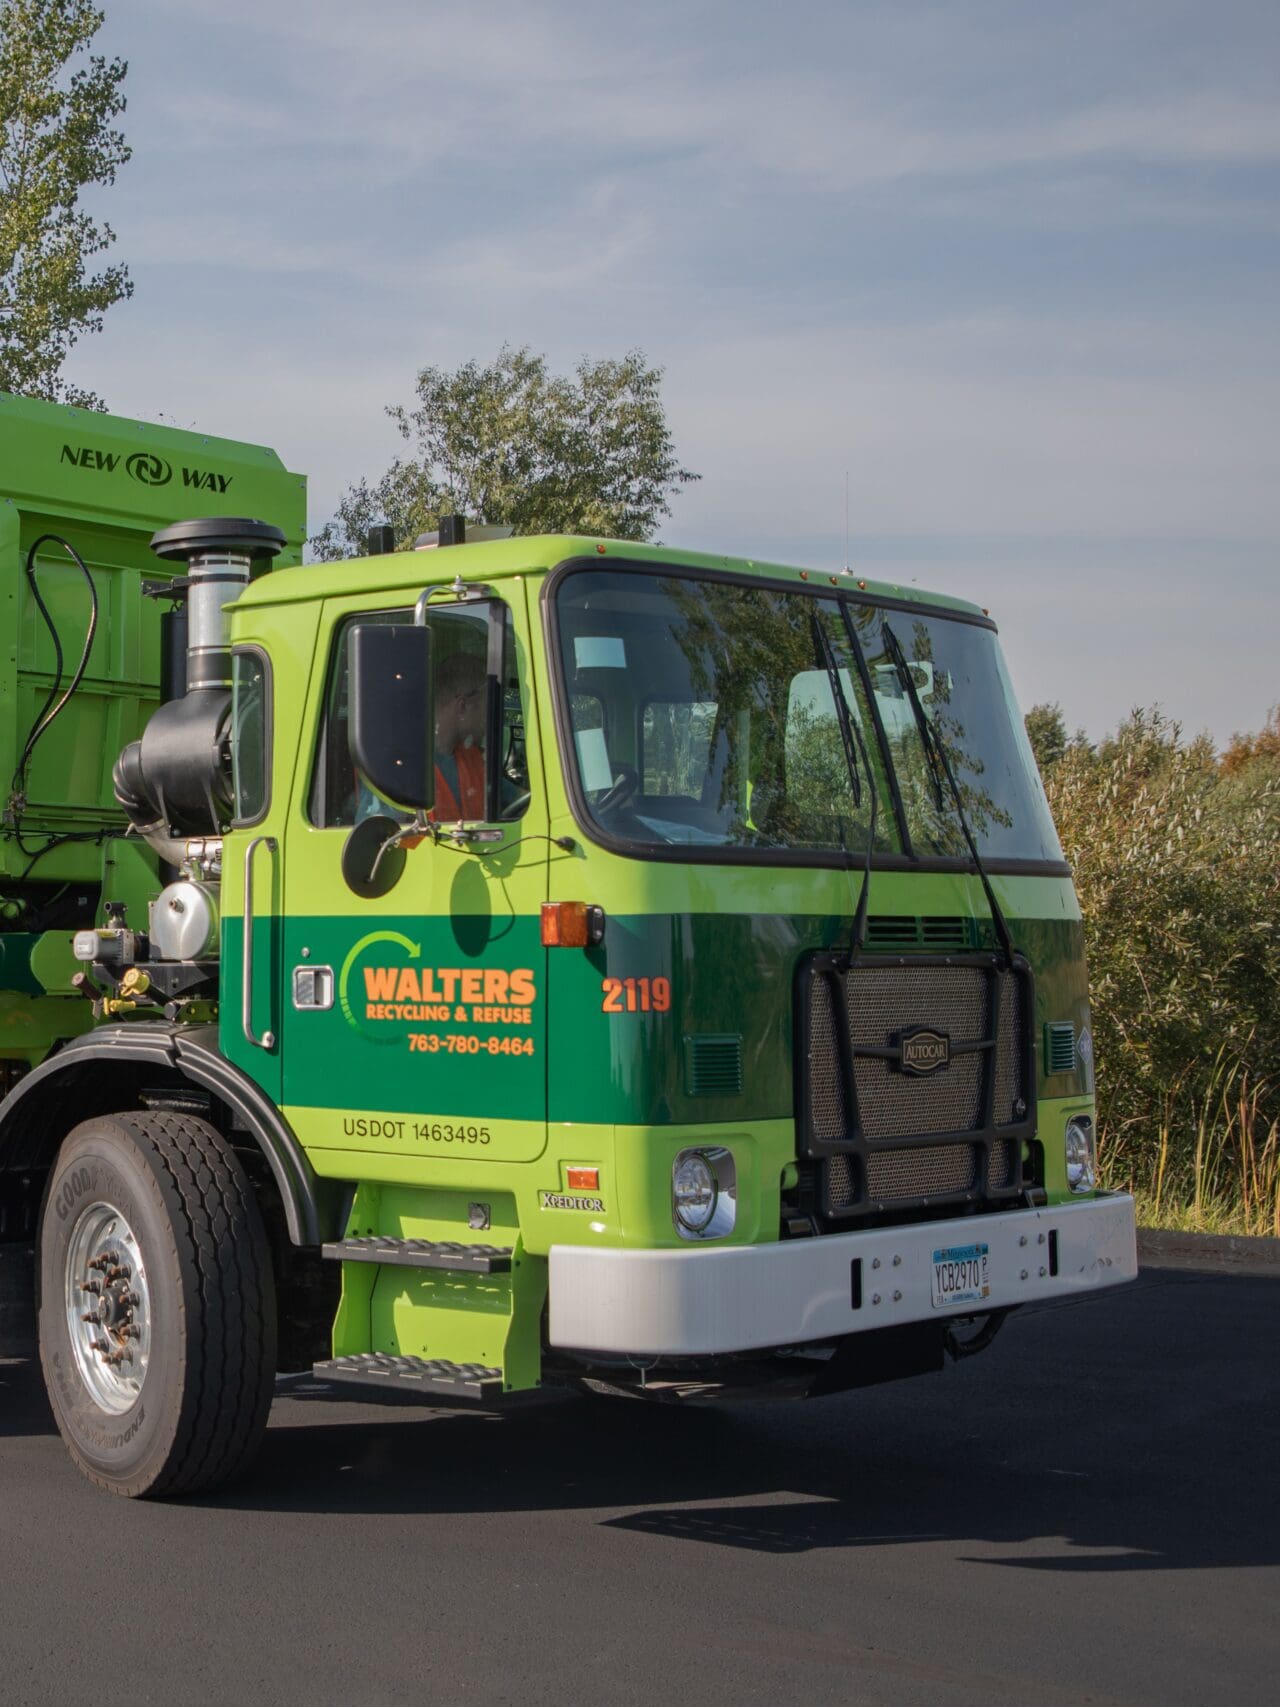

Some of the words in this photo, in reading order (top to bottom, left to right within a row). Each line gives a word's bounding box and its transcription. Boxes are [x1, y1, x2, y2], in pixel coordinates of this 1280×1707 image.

[60, 444, 121, 473] NEW
[181, 467, 233, 494] WAY
[363, 967, 537, 1005] WALTERS
[601, 975, 671, 1013] 2119
[366, 1004, 450, 1021] RECYCLING
[454, 1006, 468, 1022] &
[473, 1007, 532, 1024] REFUSE
[408, 1033, 535, 1056] 763-780-8464
[905, 1044, 946, 1059] AUTOCAR
[343, 1118, 405, 1139] USDOT
[412, 1123, 491, 1145] 1463495
[543, 1192, 606, 1212] XPEDITOR
[934, 1259, 980, 1294] YCB2970
